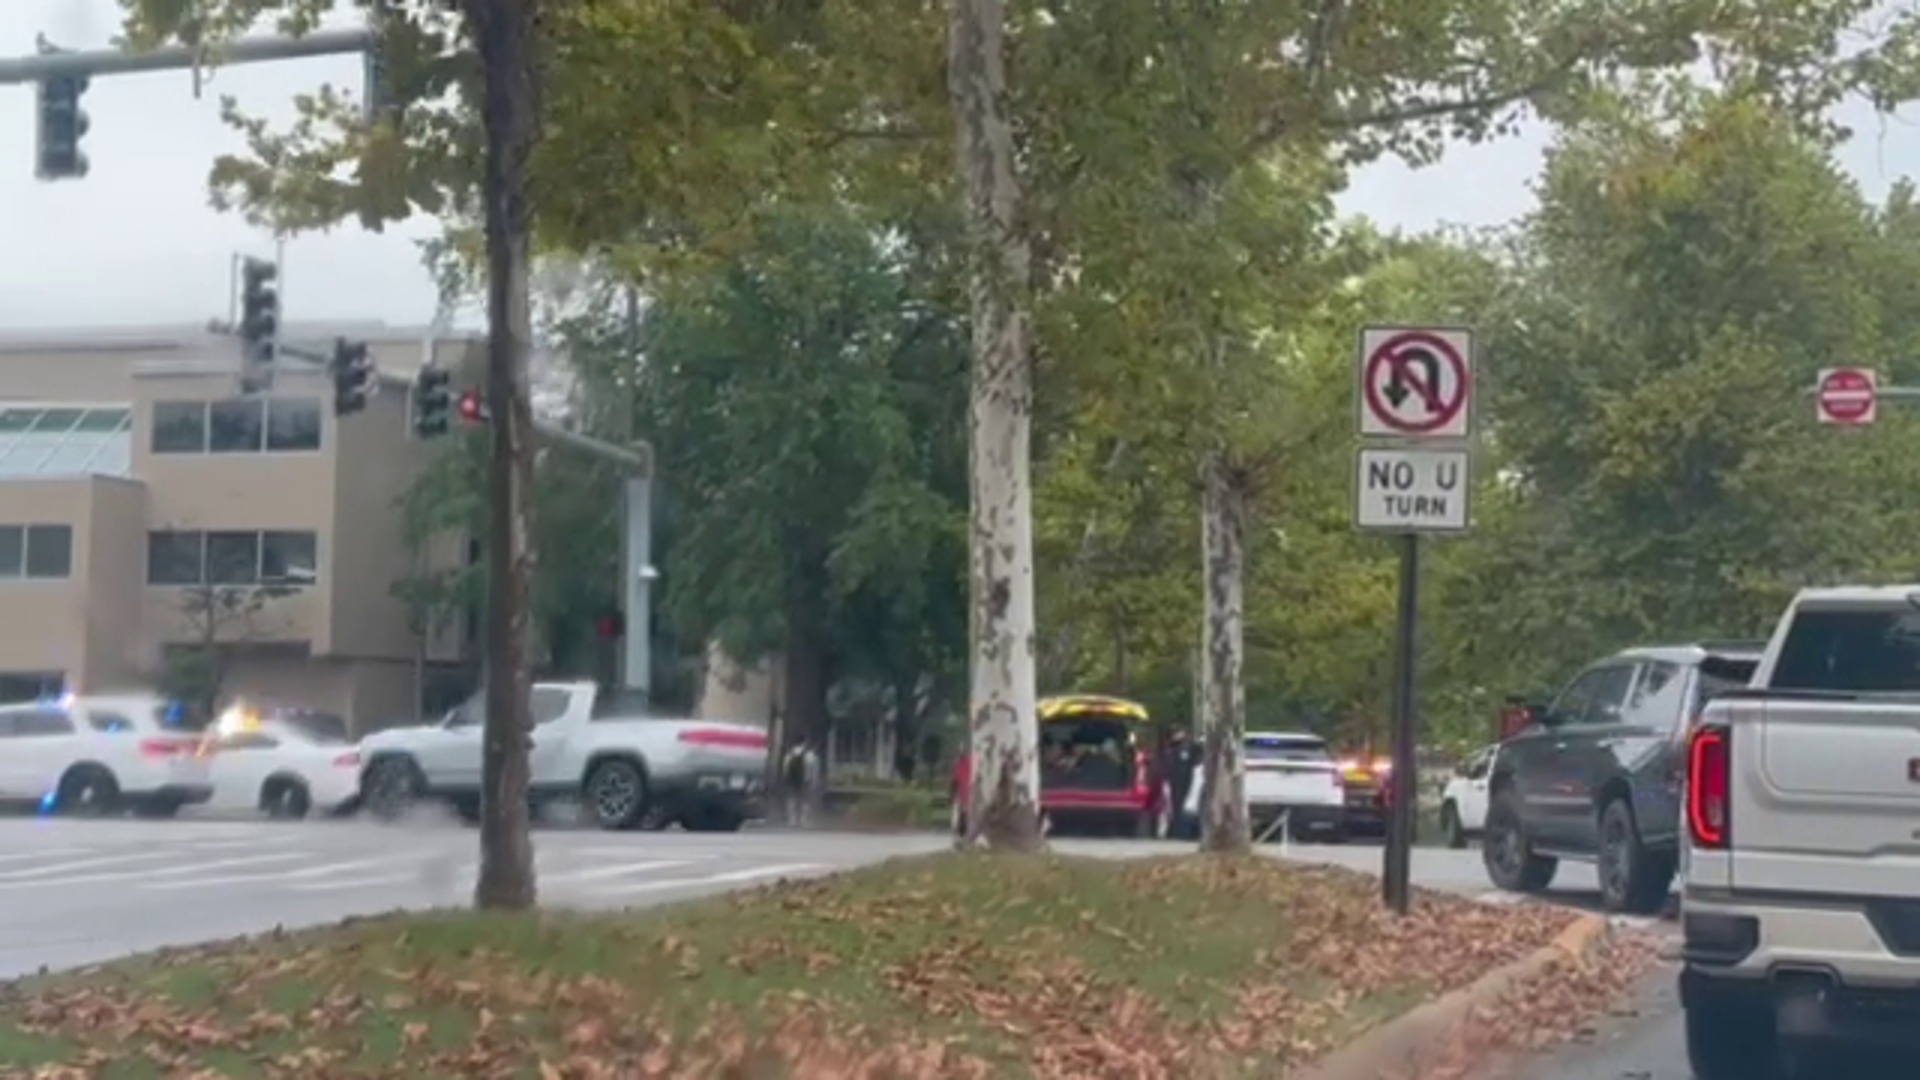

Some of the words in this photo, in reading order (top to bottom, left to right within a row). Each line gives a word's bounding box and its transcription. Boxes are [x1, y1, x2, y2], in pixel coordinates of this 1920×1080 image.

[1368, 462, 1415, 490] NO
[1436, 462, 1457, 490] U
[1384, 496, 1447, 516] TURN
